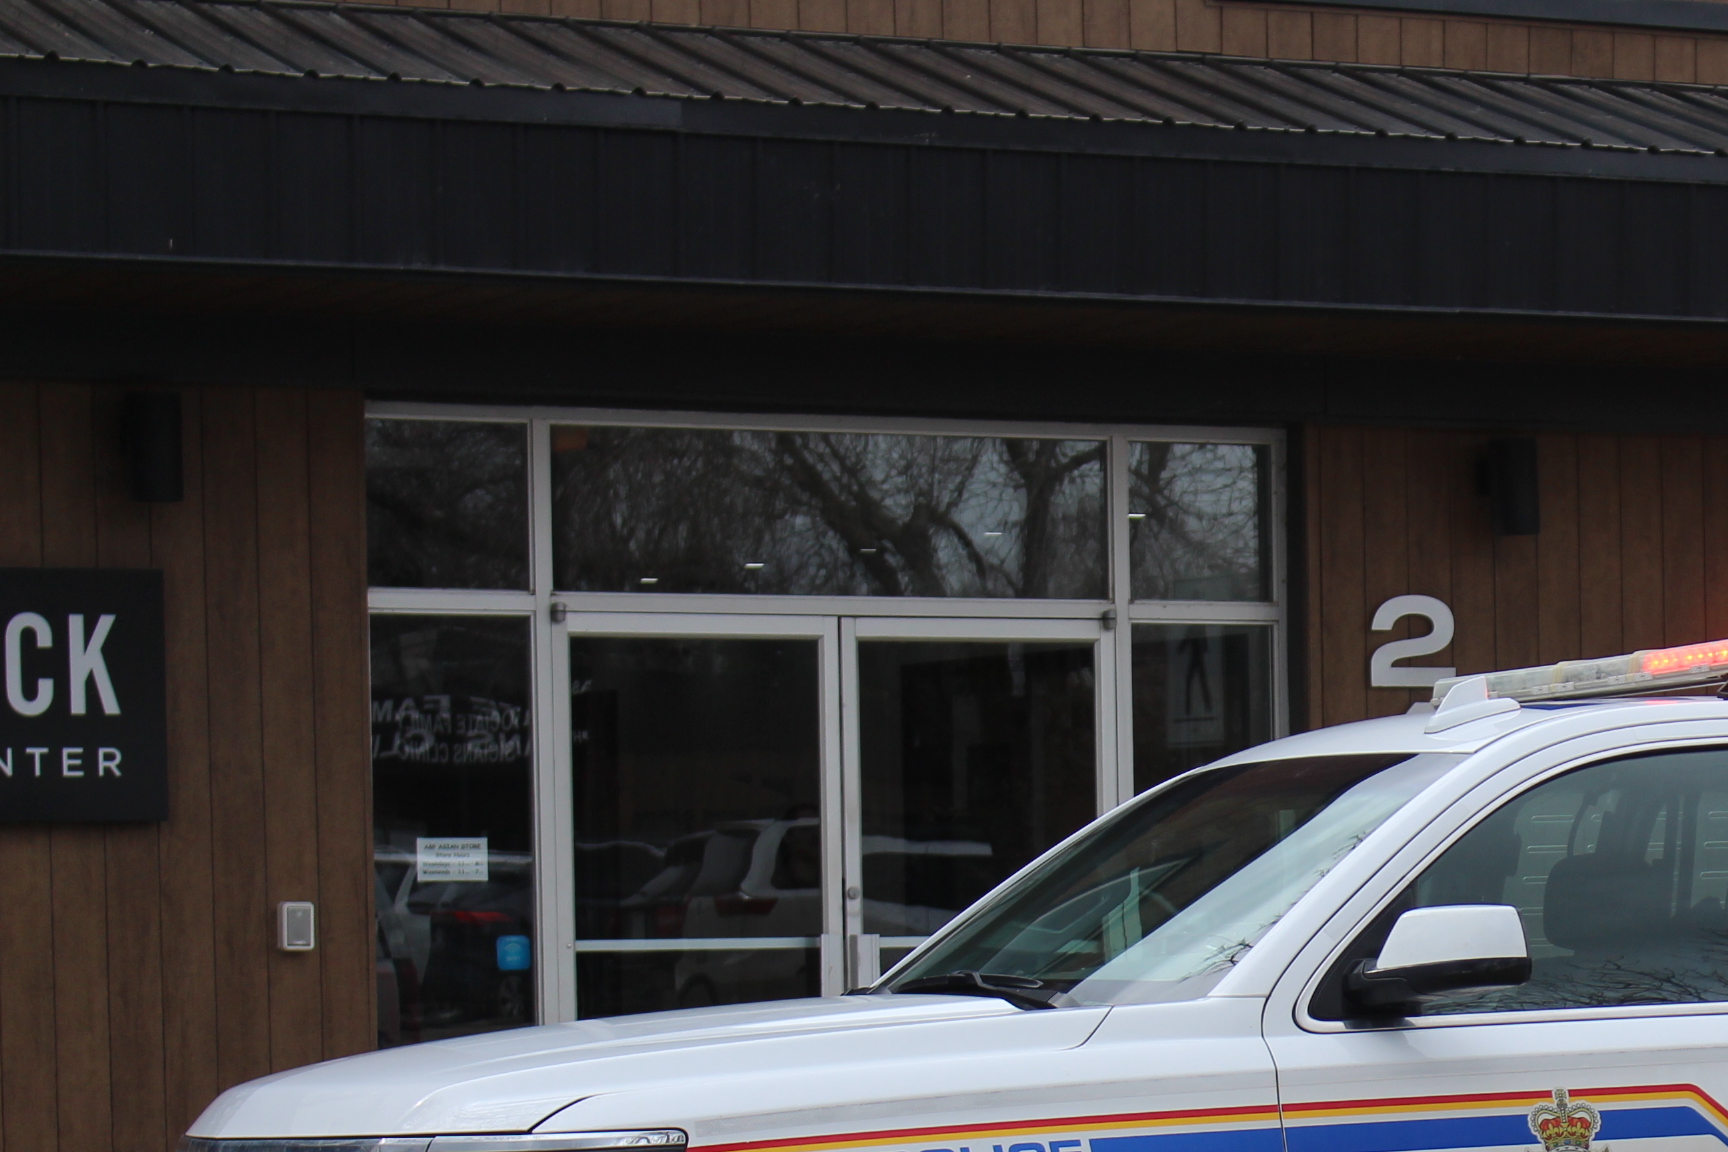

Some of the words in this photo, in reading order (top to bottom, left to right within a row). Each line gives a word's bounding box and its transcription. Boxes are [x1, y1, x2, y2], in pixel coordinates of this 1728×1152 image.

[5, 611, 121, 717] CK
[1371, 594, 1456, 687] 2
[0, 747, 122, 777] NTER
